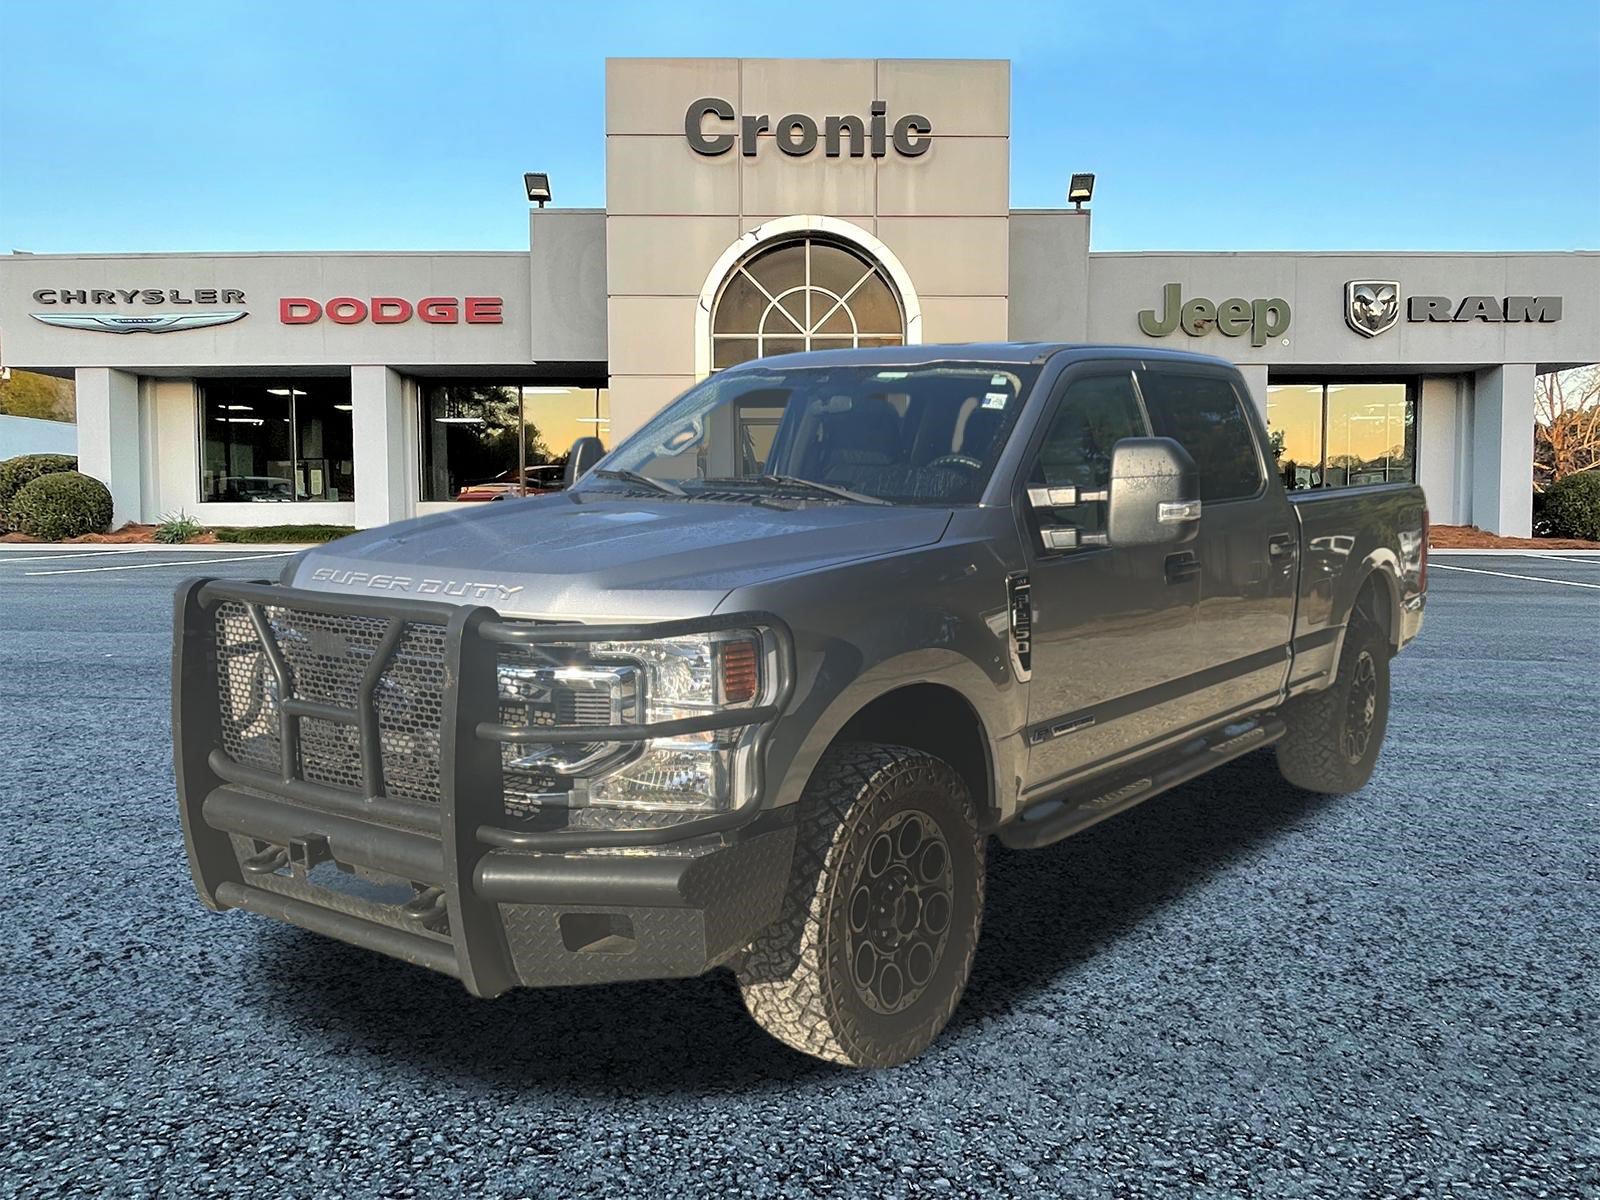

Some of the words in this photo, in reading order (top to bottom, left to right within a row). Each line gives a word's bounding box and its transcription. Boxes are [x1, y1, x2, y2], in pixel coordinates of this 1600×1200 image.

[684, 97, 933, 157] Cronic
[32, 288, 247, 305] CHRYSLER
[279, 296, 504, 325] DODGE
[1407, 296, 1563, 323] RAM
[1138, 283, 1292, 347] Jeep
[311, 567, 412, 592] SUPER
[416, 577, 525, 600] DUTY
